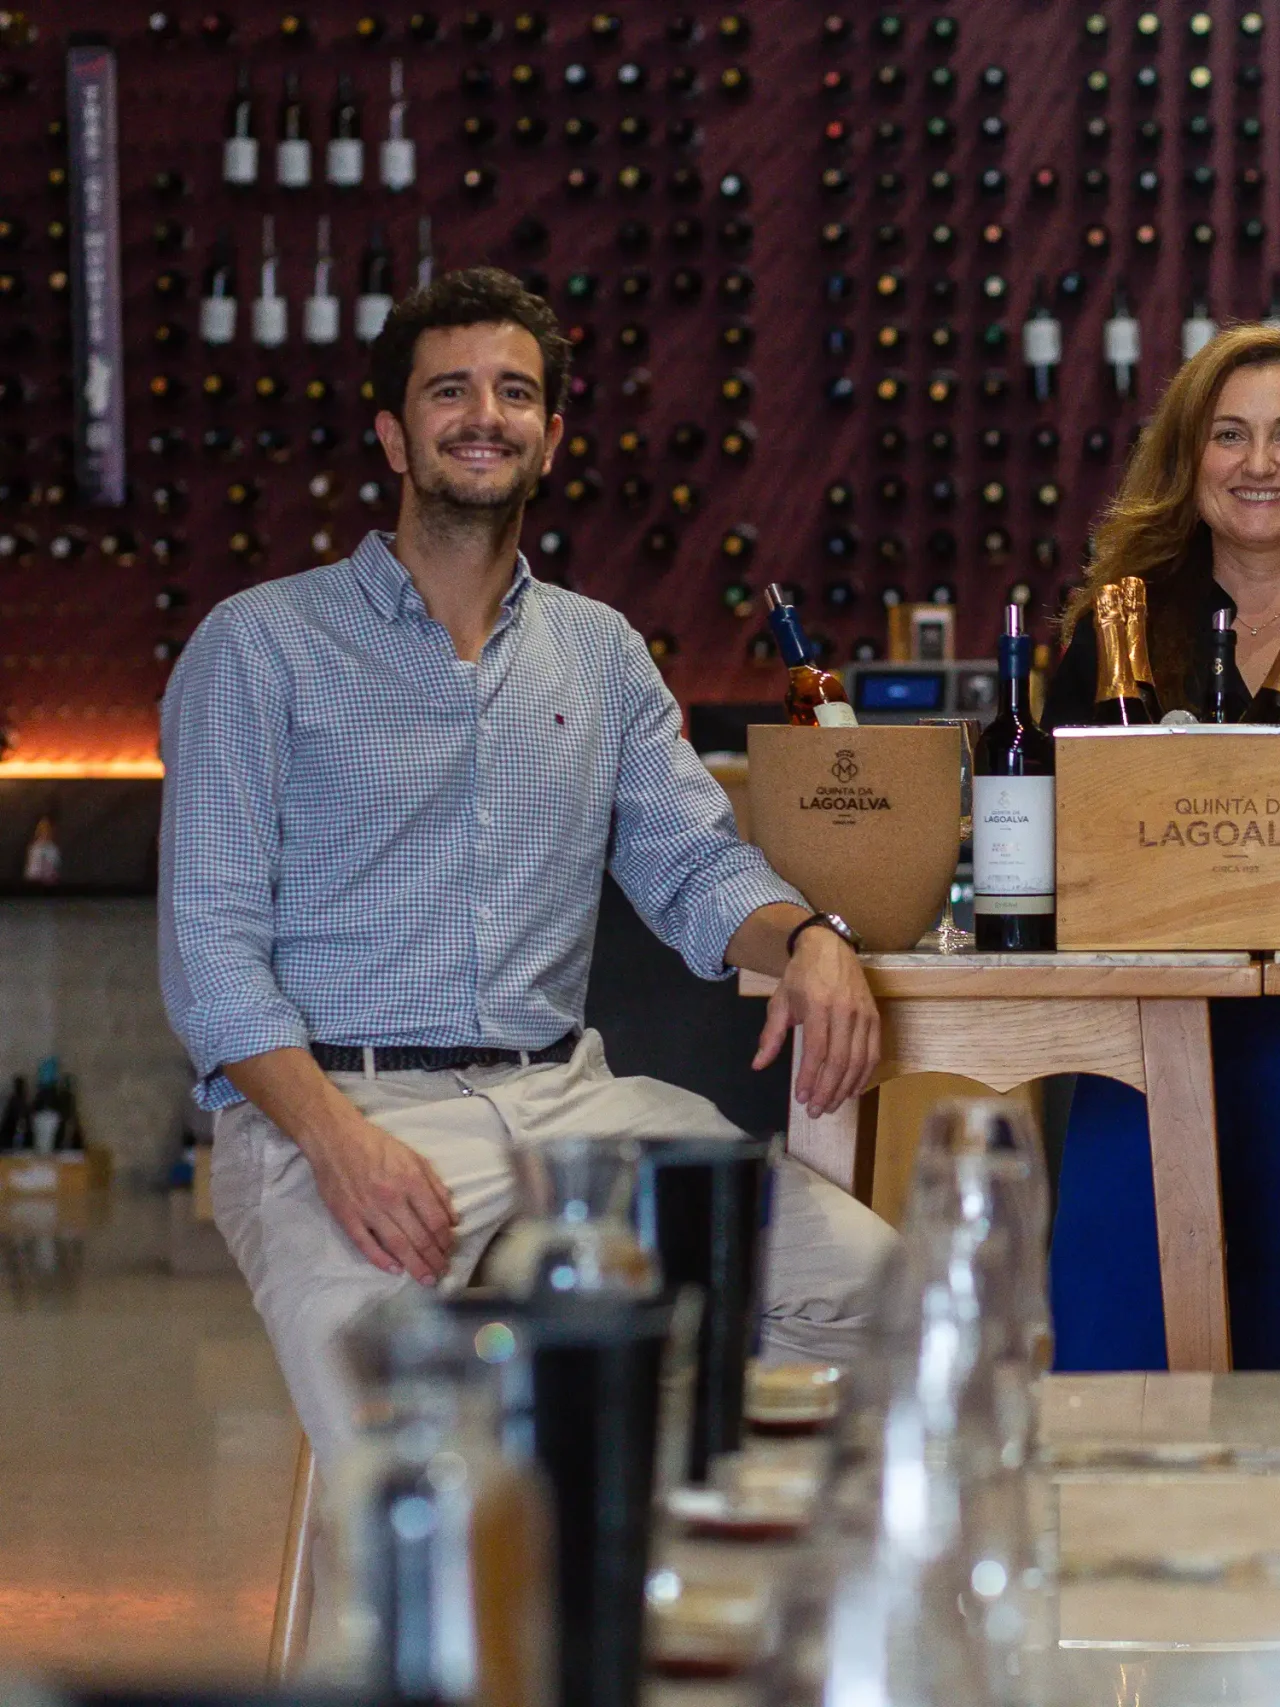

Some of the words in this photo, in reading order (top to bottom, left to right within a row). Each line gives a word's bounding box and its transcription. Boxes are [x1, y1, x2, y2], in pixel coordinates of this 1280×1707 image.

[816, 786, 855, 796] QUINTA
[858, 787, 874, 796] DA
[800, 797, 891, 810] LAGOALVA
[1174, 798, 1257, 816] QUINTA
[983, 815, 1030, 823] LAGOALVA
